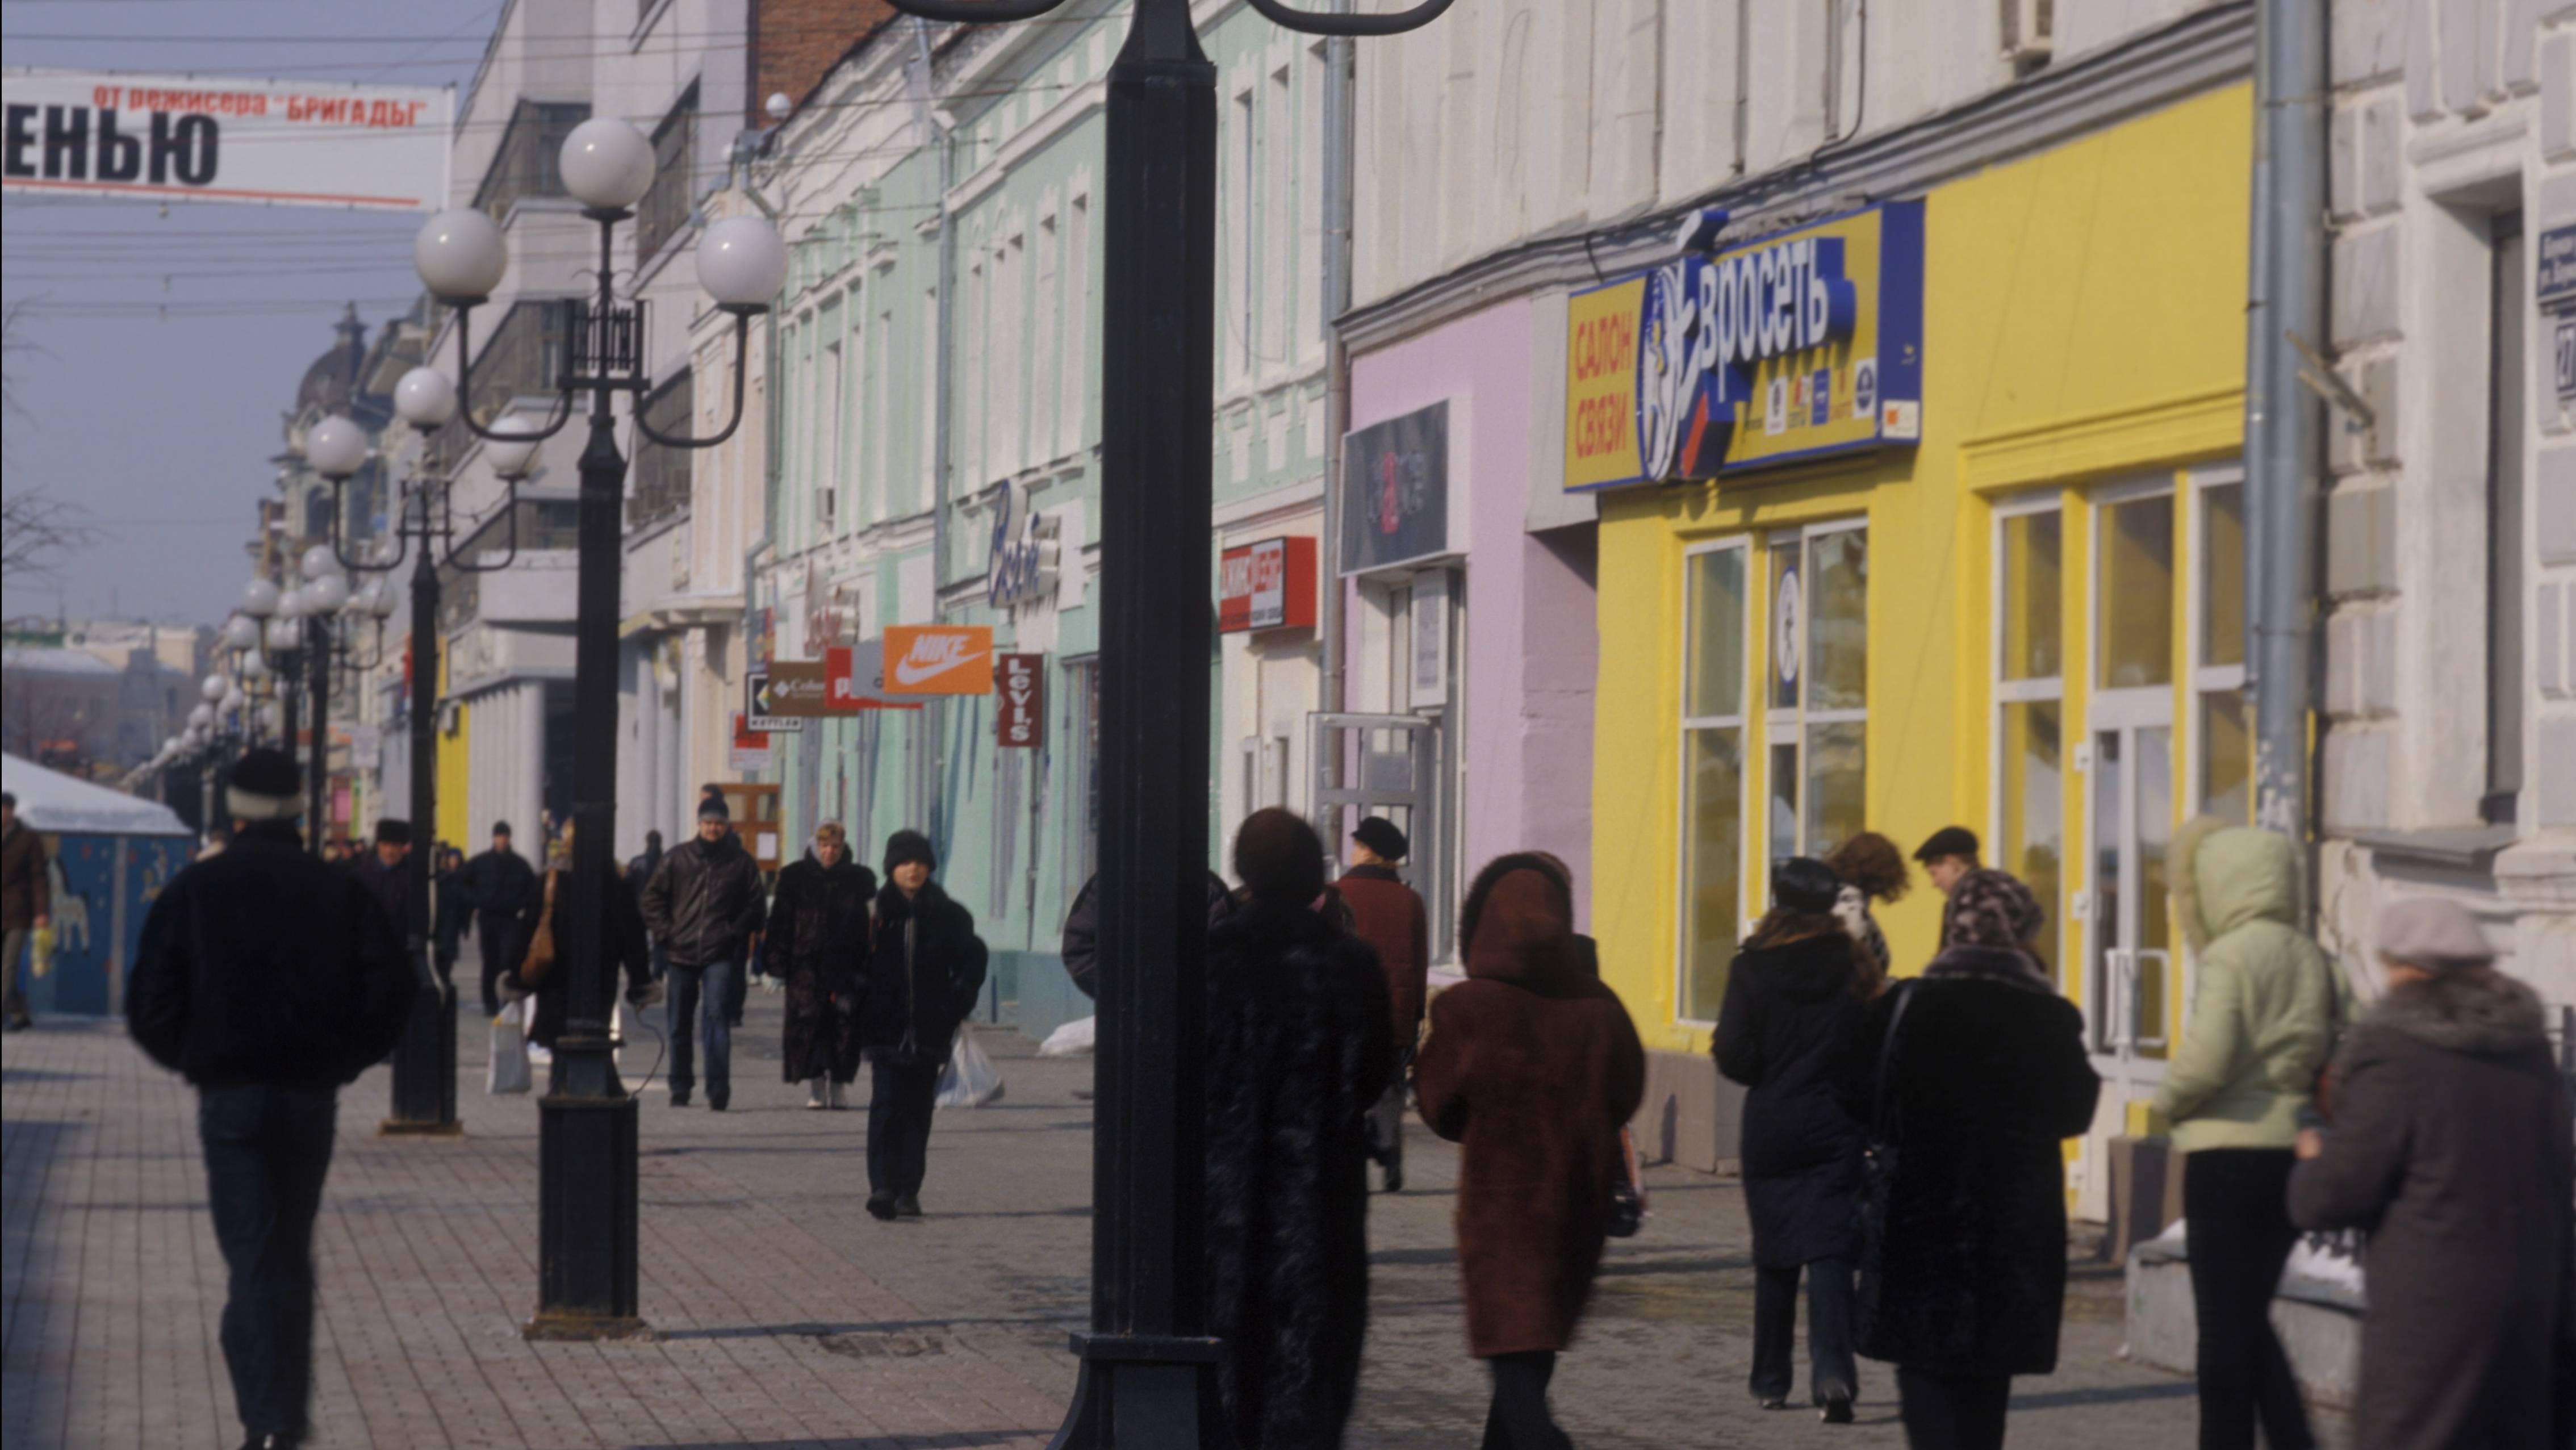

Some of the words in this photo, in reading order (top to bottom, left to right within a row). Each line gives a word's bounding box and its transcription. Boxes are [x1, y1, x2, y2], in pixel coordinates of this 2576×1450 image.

[93, 84, 122, 108] от
[274, 94, 426, 128] "БРИГАДЫ"
[1575, 310, 1633, 381] САЛОН
[1575, 391, 1628, 459] СВЯЗИ
[910, 634, 969, 661] NIKE
